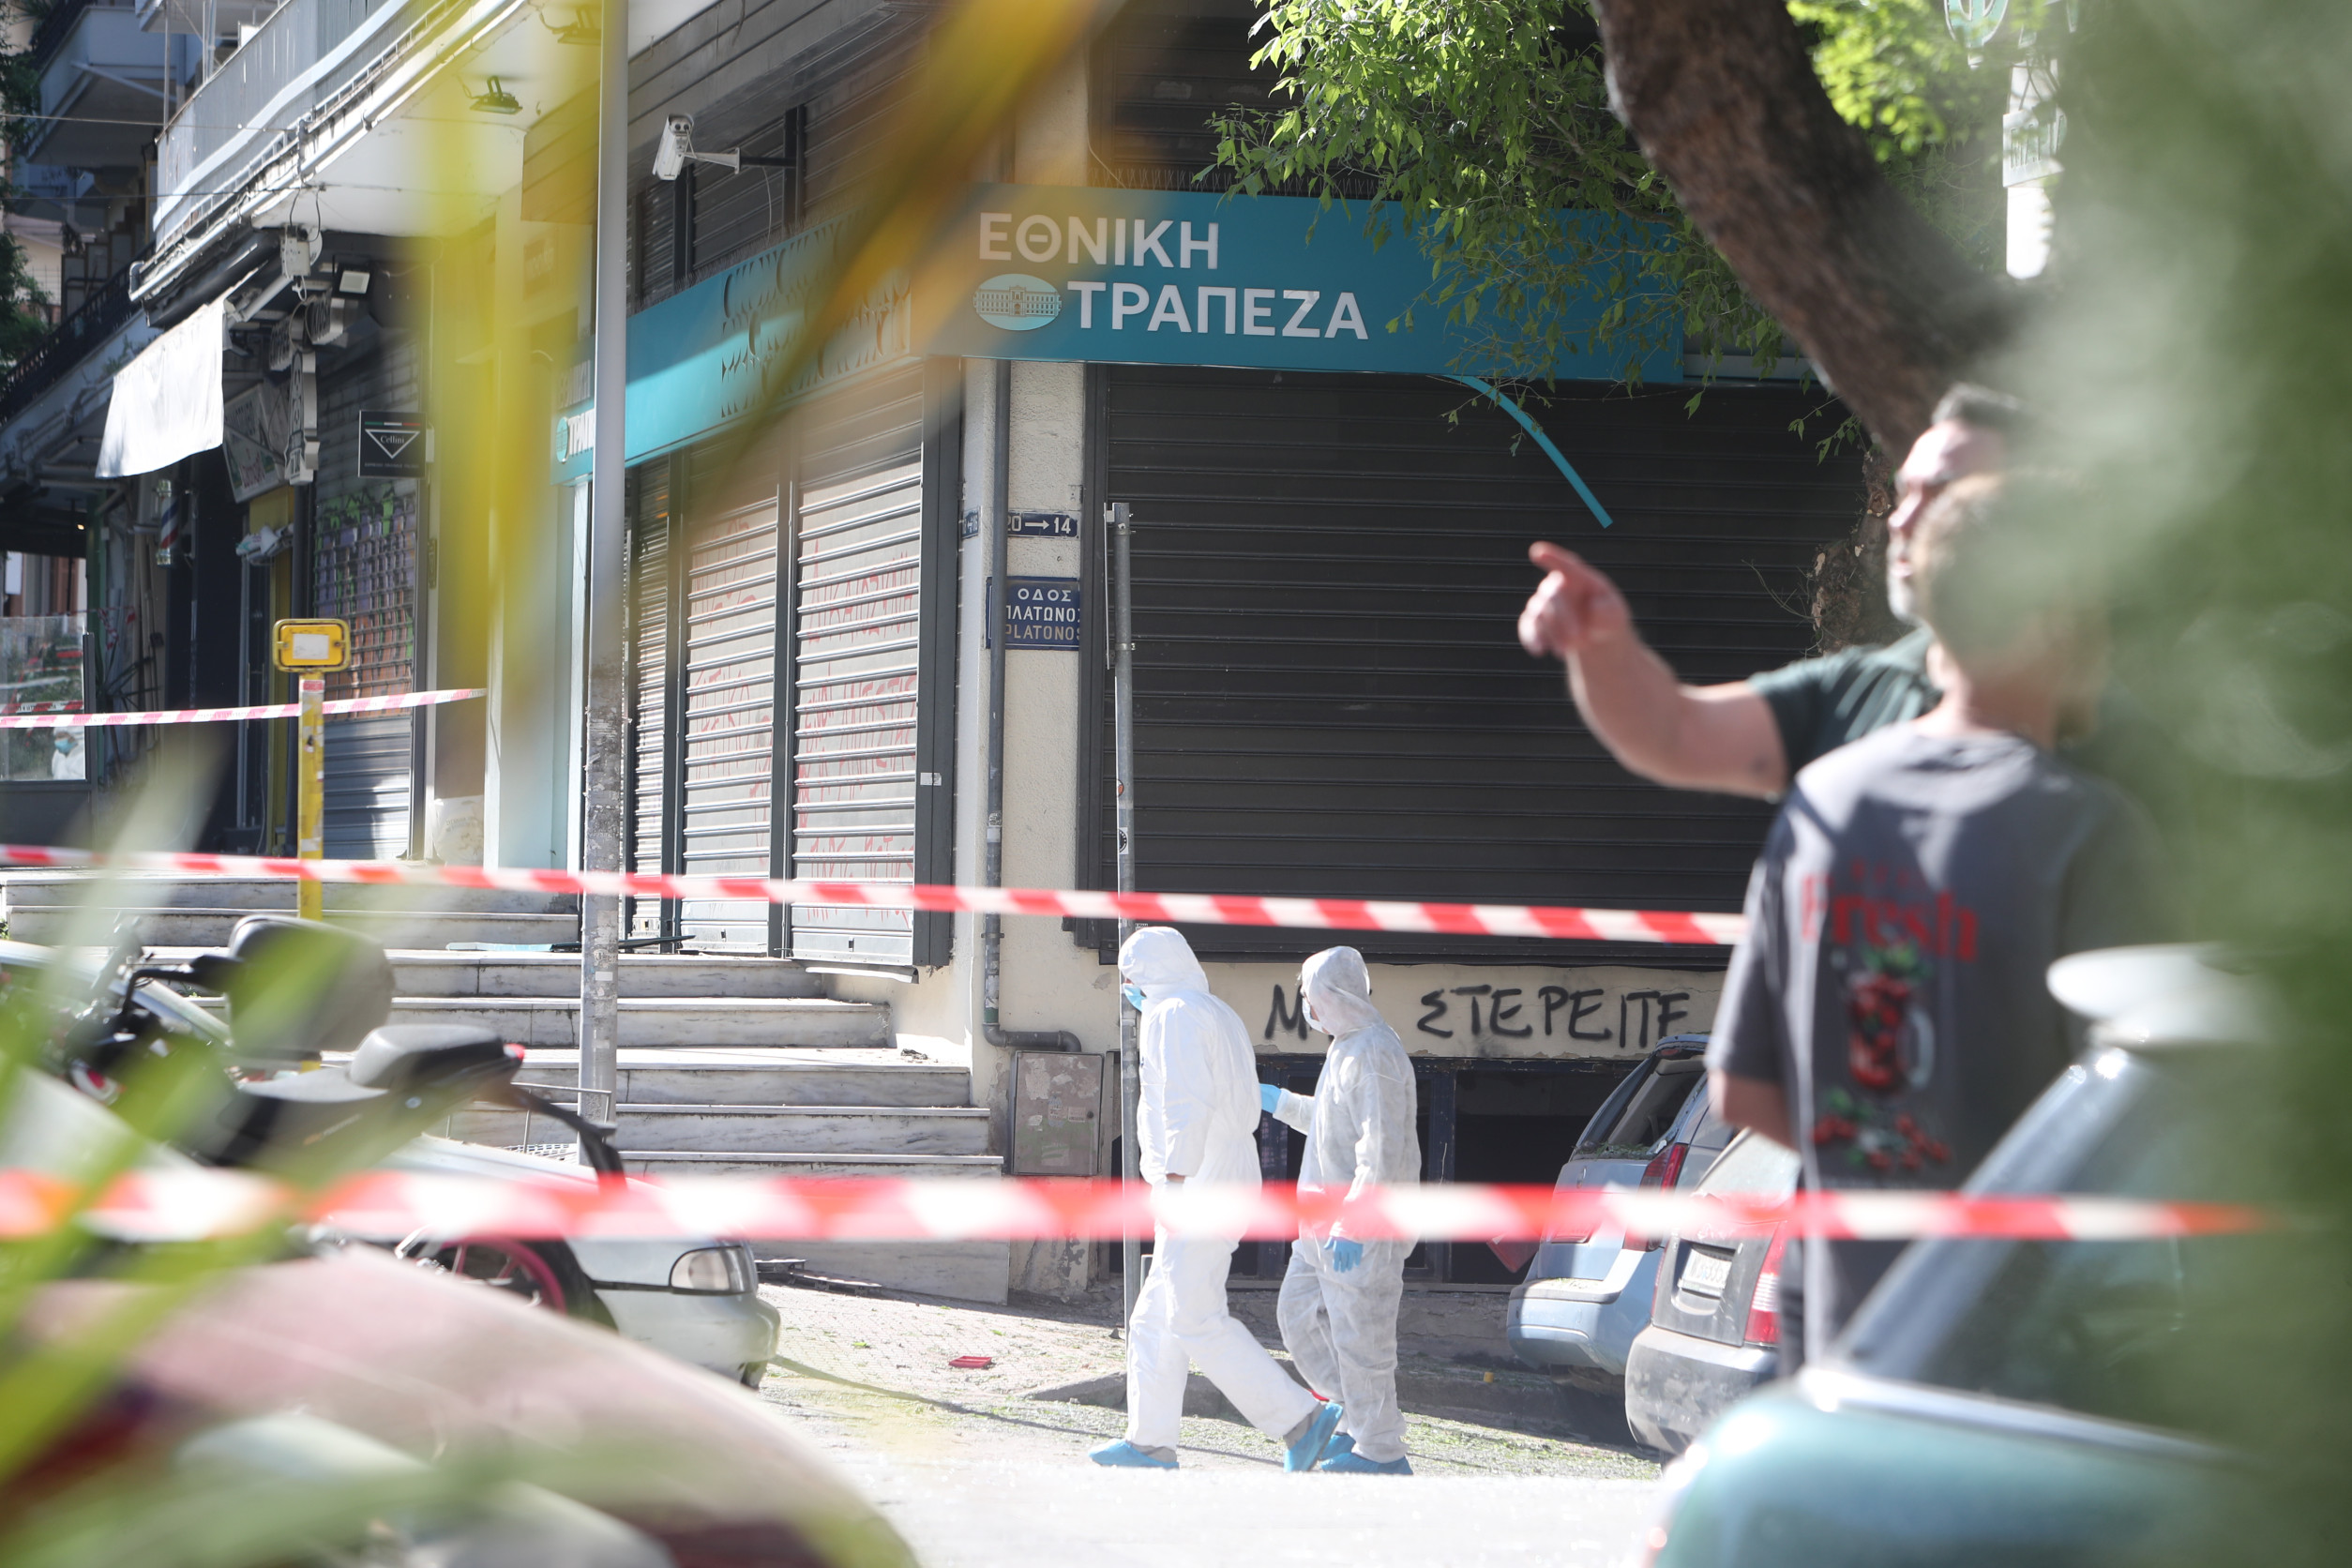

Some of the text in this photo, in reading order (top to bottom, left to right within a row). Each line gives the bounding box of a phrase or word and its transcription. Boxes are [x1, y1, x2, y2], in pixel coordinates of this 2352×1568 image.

[978, 211, 1219, 269] ΕΘΝΙΚΗ
[1066, 280, 1369, 340] ΤΡΑΠΕΖΑ
[380, 435, 405, 445] Cellini
[1053, 517, 1072, 535] 14
[1018, 588, 1072, 602] ΟΔΟΣ
